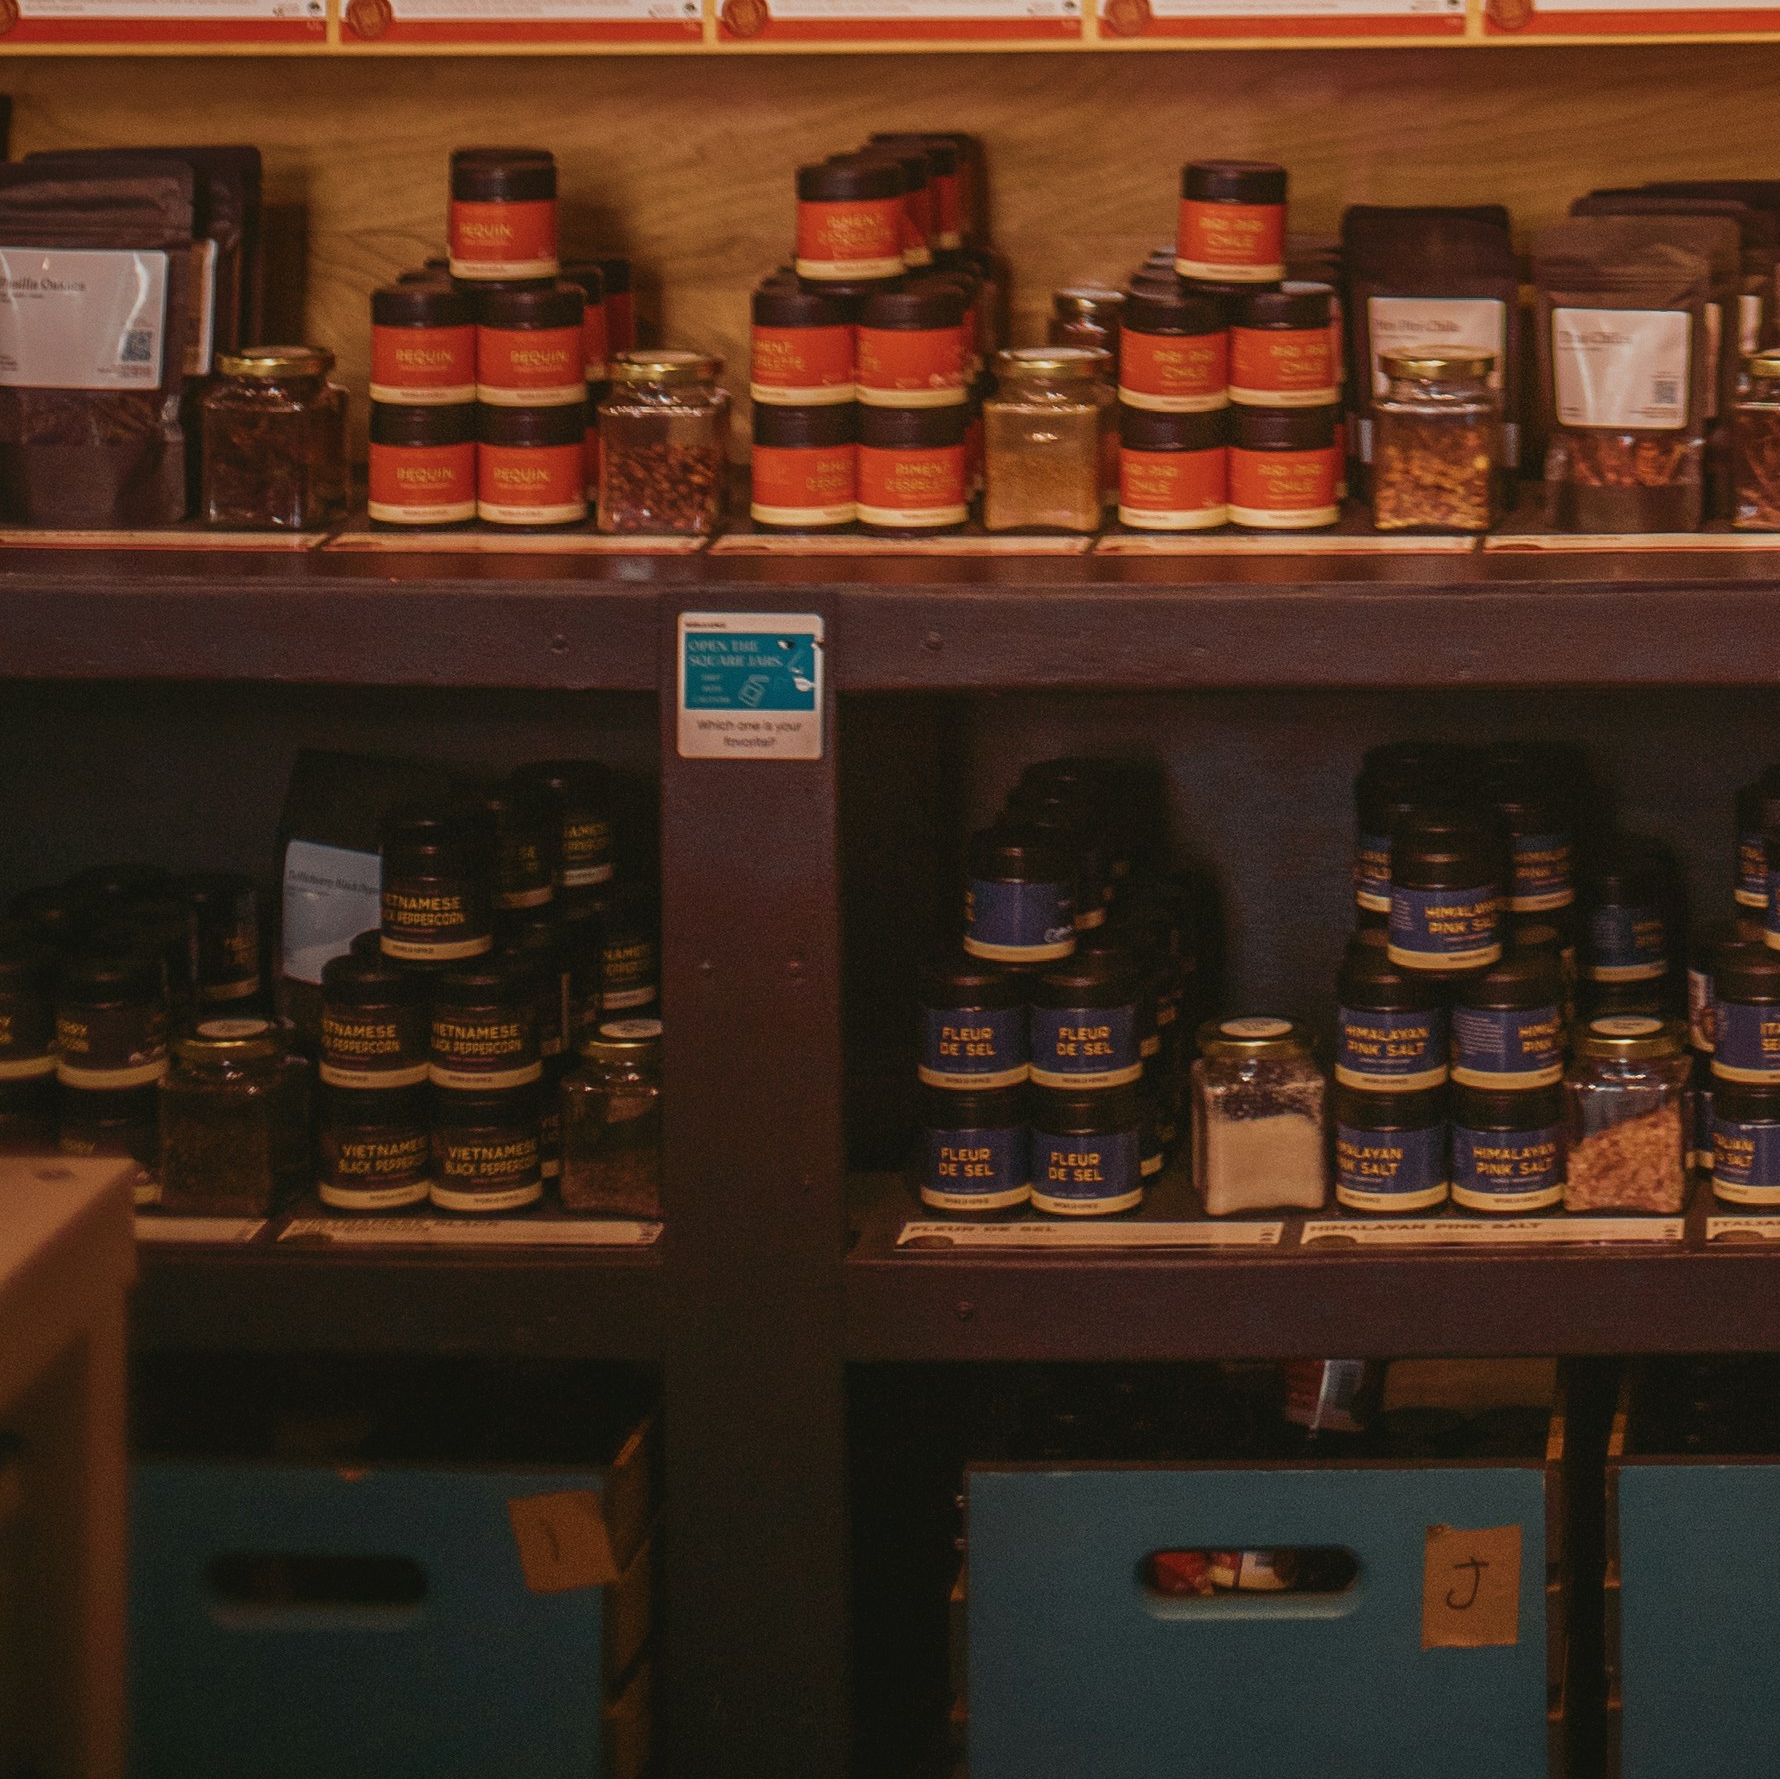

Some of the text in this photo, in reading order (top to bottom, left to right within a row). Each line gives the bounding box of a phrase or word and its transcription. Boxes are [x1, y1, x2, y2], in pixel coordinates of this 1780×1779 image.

[941, 1026, 994, 1042] FLEUR
[1058, 1025, 1112, 1042] FLEUR
[939, 1041, 997, 1057] DE SEL
[1055, 1041, 1114, 1056] DE SEL
[1346, 1041, 1426, 1057] PINK SALT
[940, 1147, 992, 1163] FLEUR
[1049, 1151, 1101, 1167] FLEUR
[938, 1162, 995, 1177] DE SEL
[1047, 1166, 1105, 1182] DE SEL
[1360, 1162, 1401, 1177] SALT
[1475, 1158, 1553, 1176] PINK SALT
[1446, 1556, 1490, 1611] J
